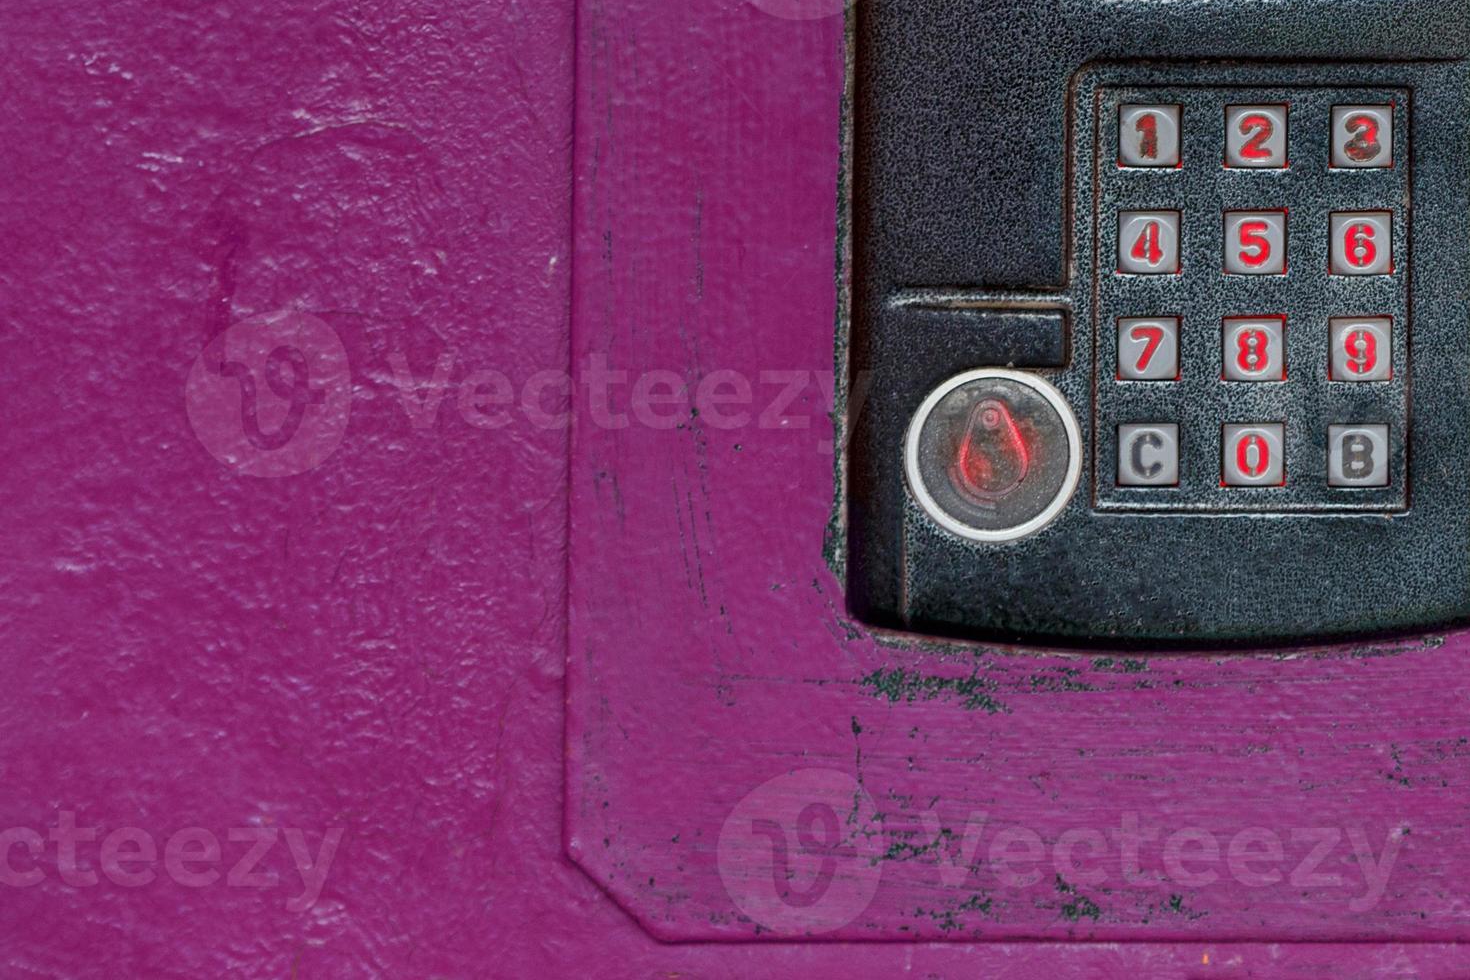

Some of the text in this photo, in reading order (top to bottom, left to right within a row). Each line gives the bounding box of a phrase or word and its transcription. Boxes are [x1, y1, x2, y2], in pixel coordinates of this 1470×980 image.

[1134, 113, 1382, 163] 1 2 3
[1130, 220, 1377, 269] 4 5 6
[1129, 325, 1378, 375] 7 8 9
[1129, 433, 1375, 480] C 0 B
